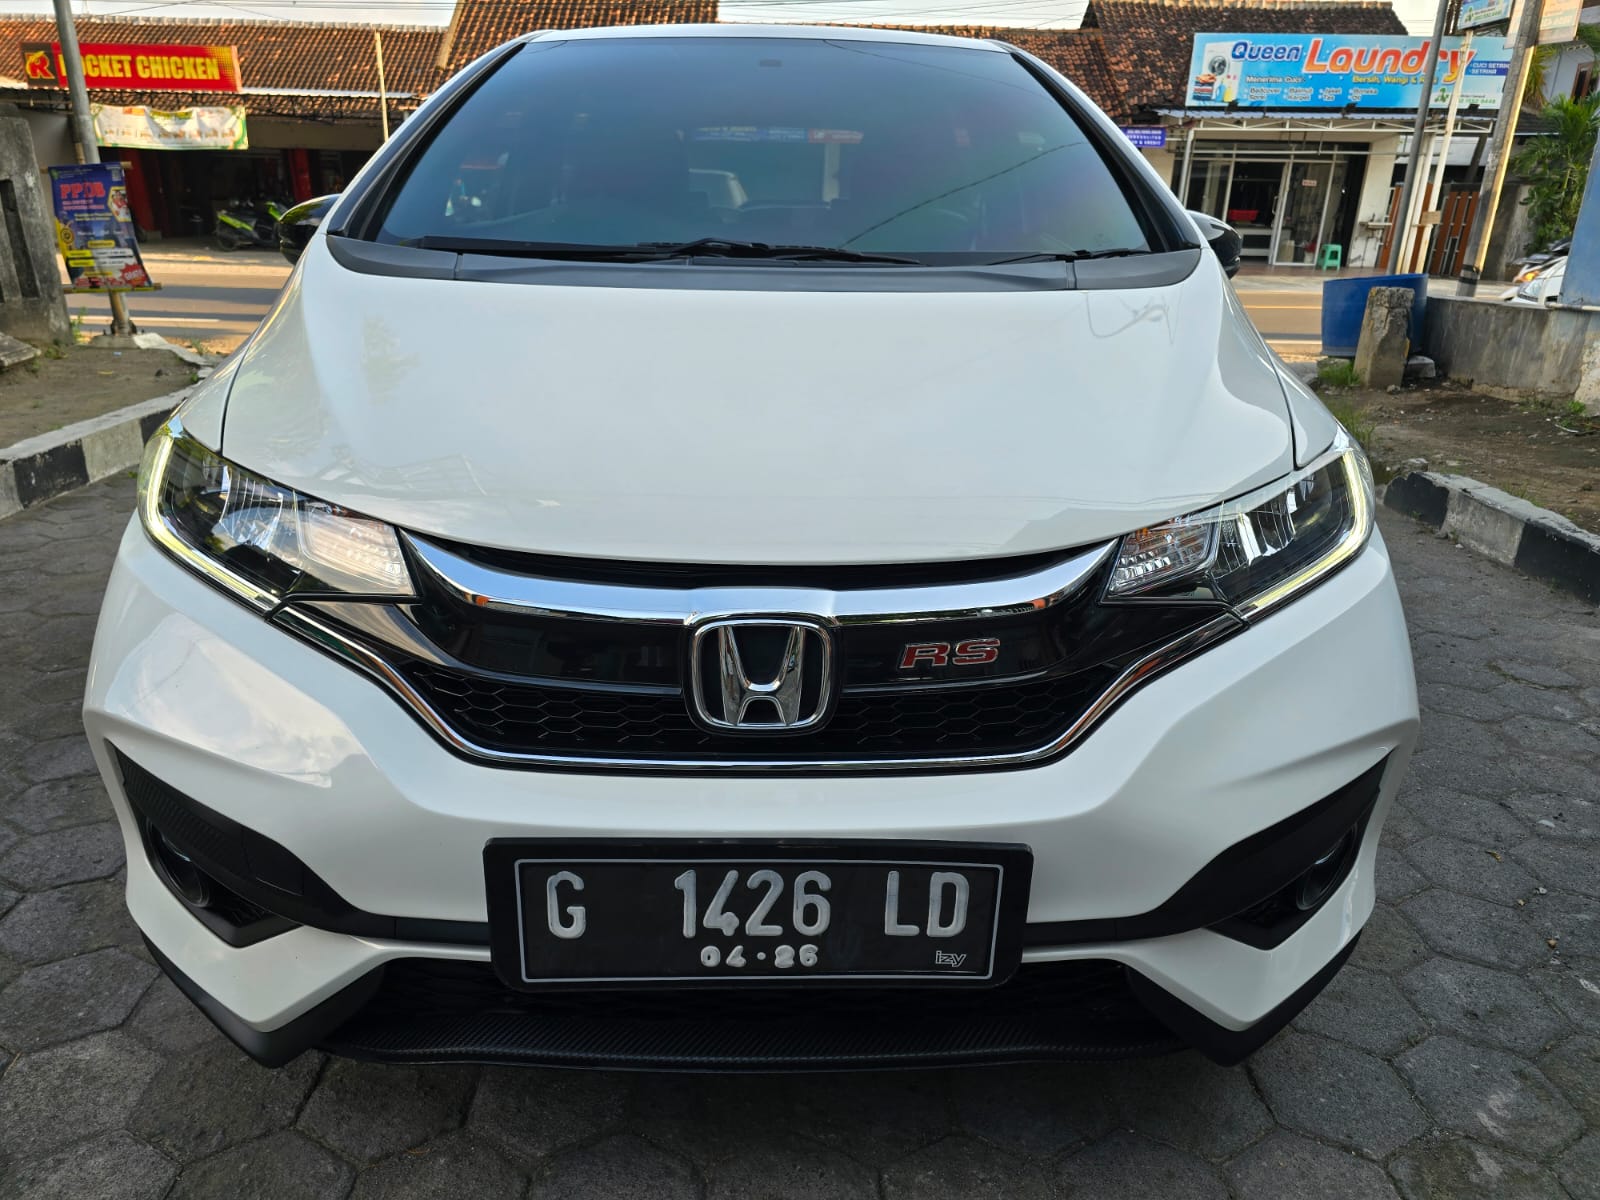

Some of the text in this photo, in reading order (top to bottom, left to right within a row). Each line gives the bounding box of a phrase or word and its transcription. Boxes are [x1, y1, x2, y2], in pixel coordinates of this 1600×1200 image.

[1231, 40, 1302, 61] Queen
[136, 55, 220, 80] CHICKEN
[899, 638, 1001, 669] RS
[546, 870, 970, 939] G 1426 LD
